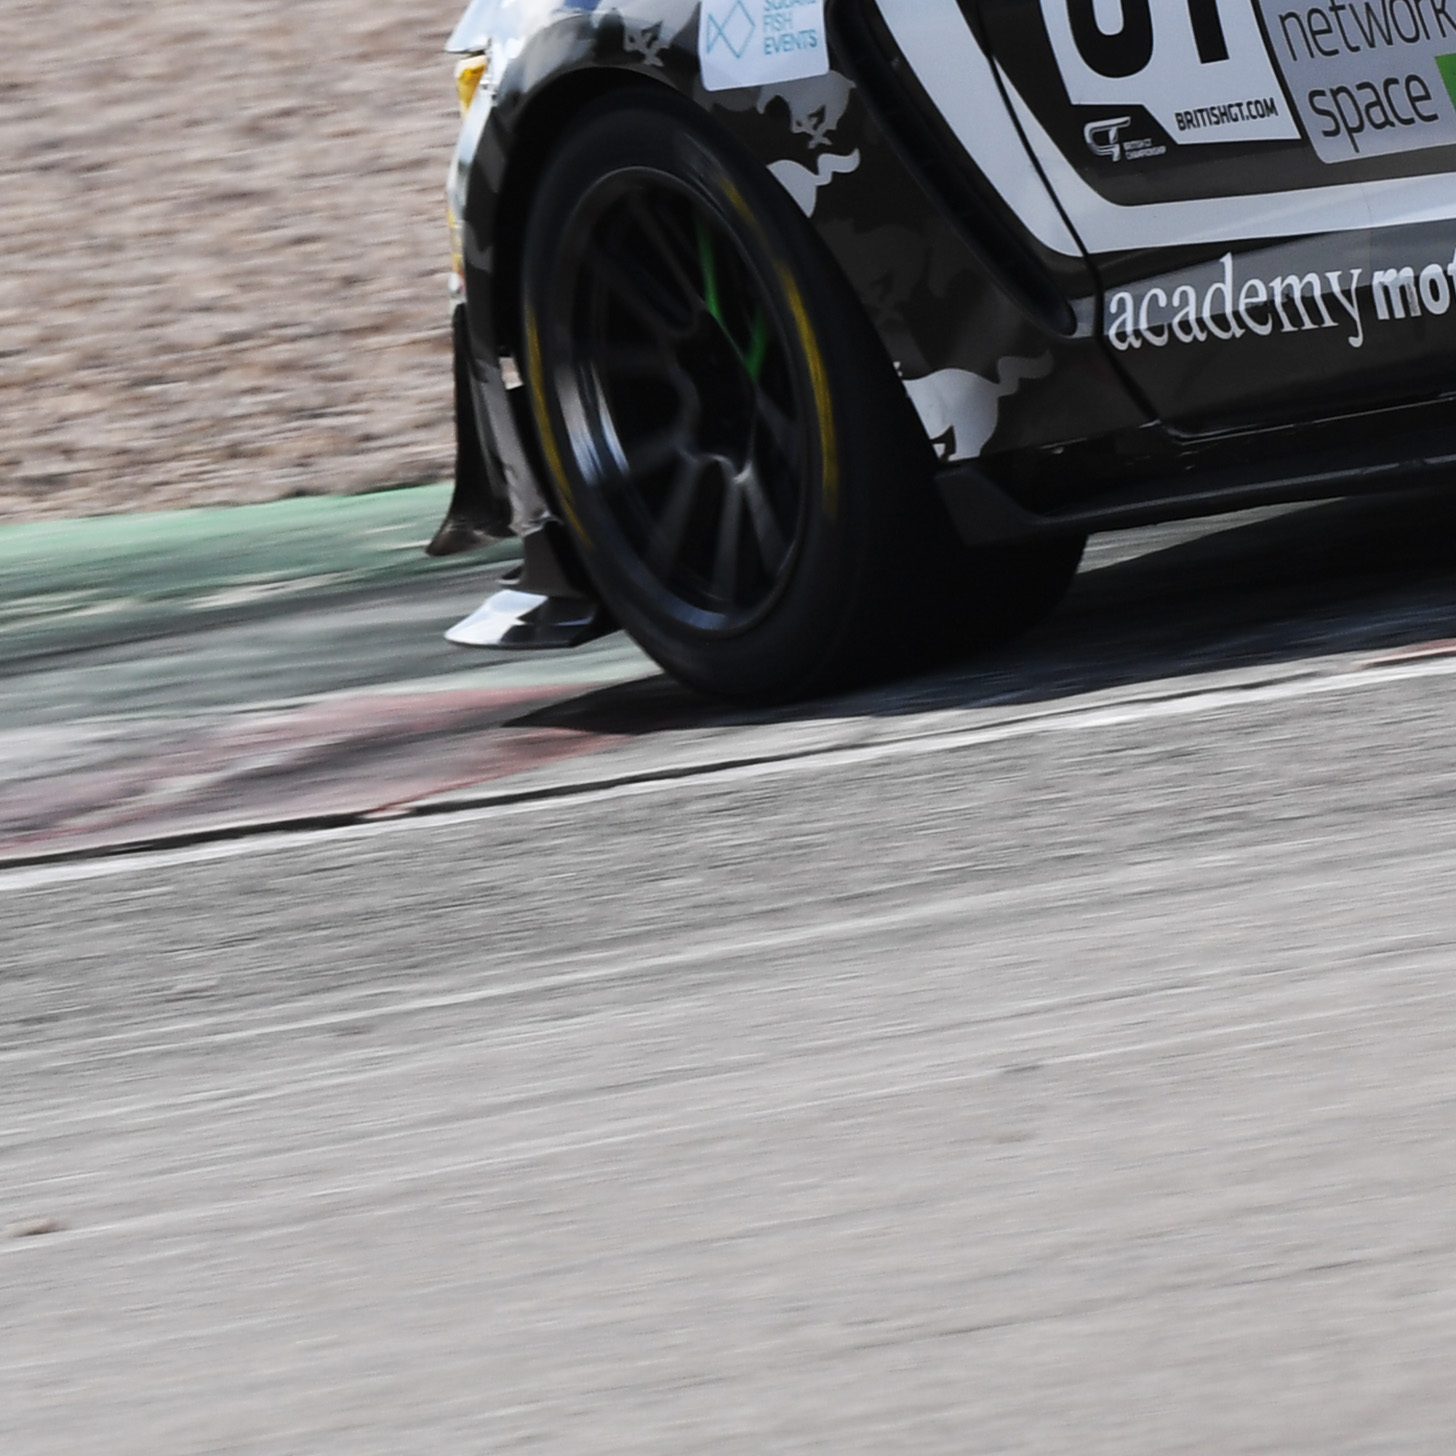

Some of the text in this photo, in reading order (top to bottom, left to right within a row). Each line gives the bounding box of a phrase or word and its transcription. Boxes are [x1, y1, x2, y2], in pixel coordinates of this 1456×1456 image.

[763, 10, 793, 36] FISH
[763, 29, 818, 57] EVENTS
[1175, 97, 1278, 131] BRITISHGT.COM
[1307, 70, 1439, 153] space
[1107, 253, 1363, 350] academy
